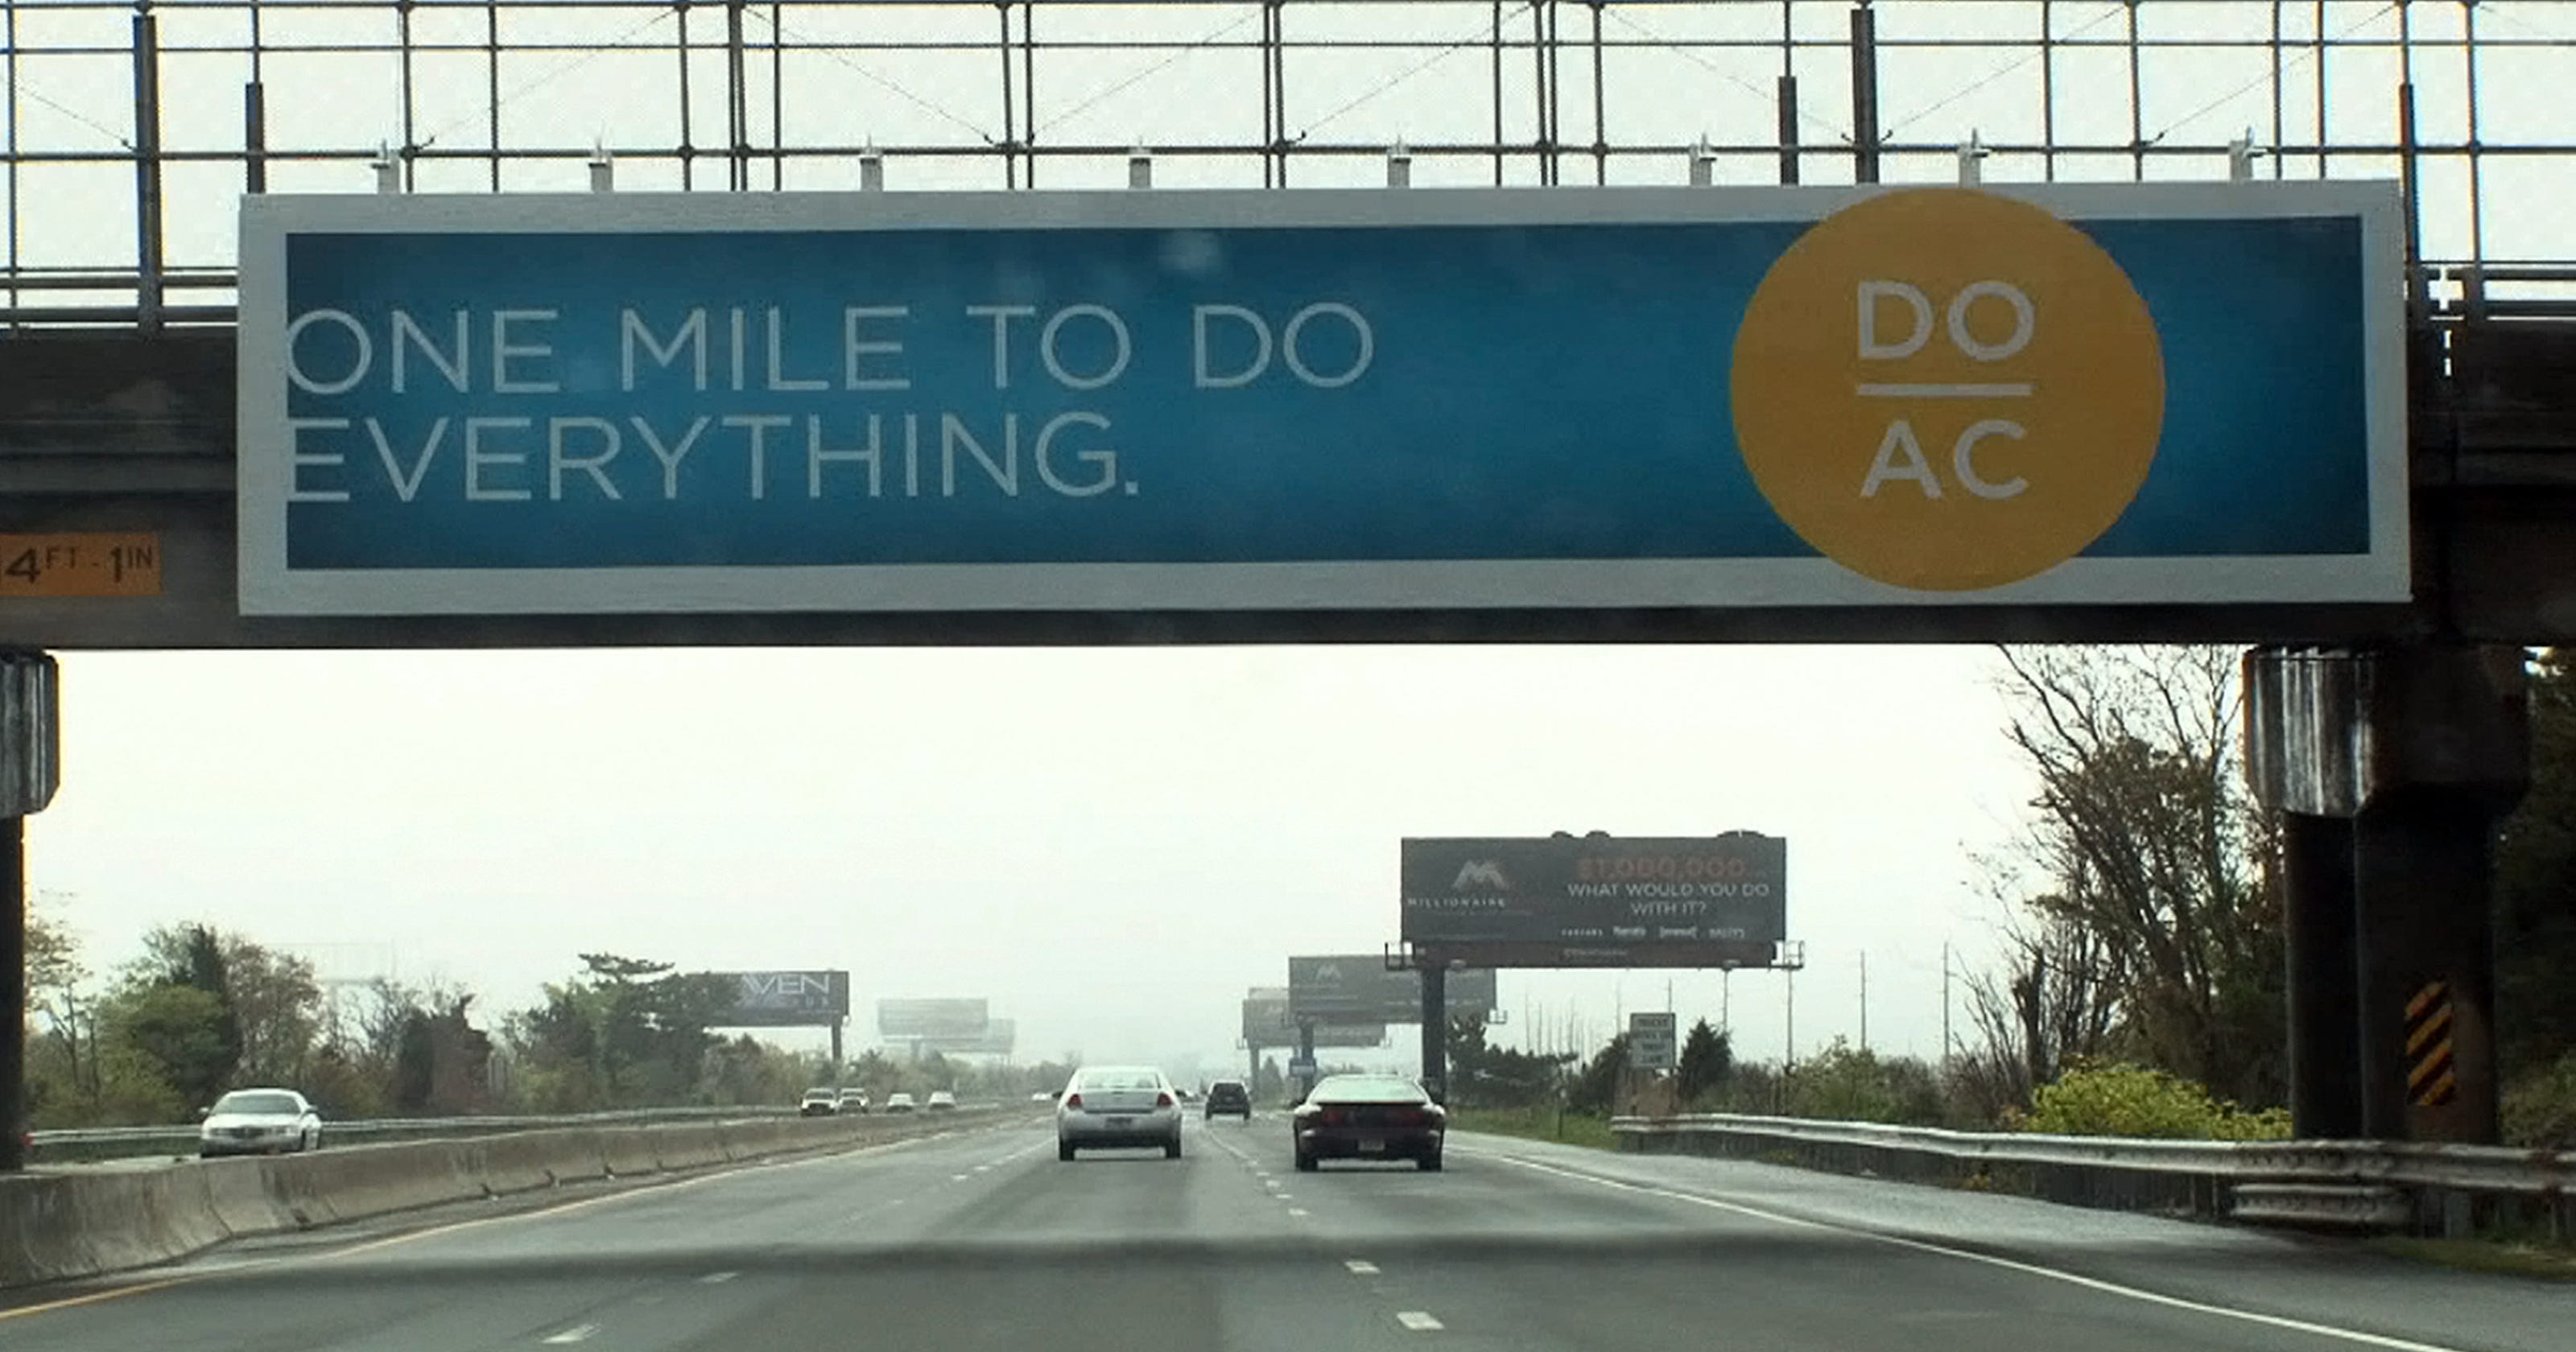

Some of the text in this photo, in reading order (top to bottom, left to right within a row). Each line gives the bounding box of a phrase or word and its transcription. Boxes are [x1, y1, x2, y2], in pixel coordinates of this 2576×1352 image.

[287, 302, 1375, 394] ONE MILE TO DO
[1858, 280, 2036, 361] DO
[287, 411, 1139, 501] EVERYTHING.
[1860, 418, 2029, 501] AC
[1567, 884, 1770, 897] WHAT WOULD YOU DO
[1630, 901, 1707, 916] WITH IT?
